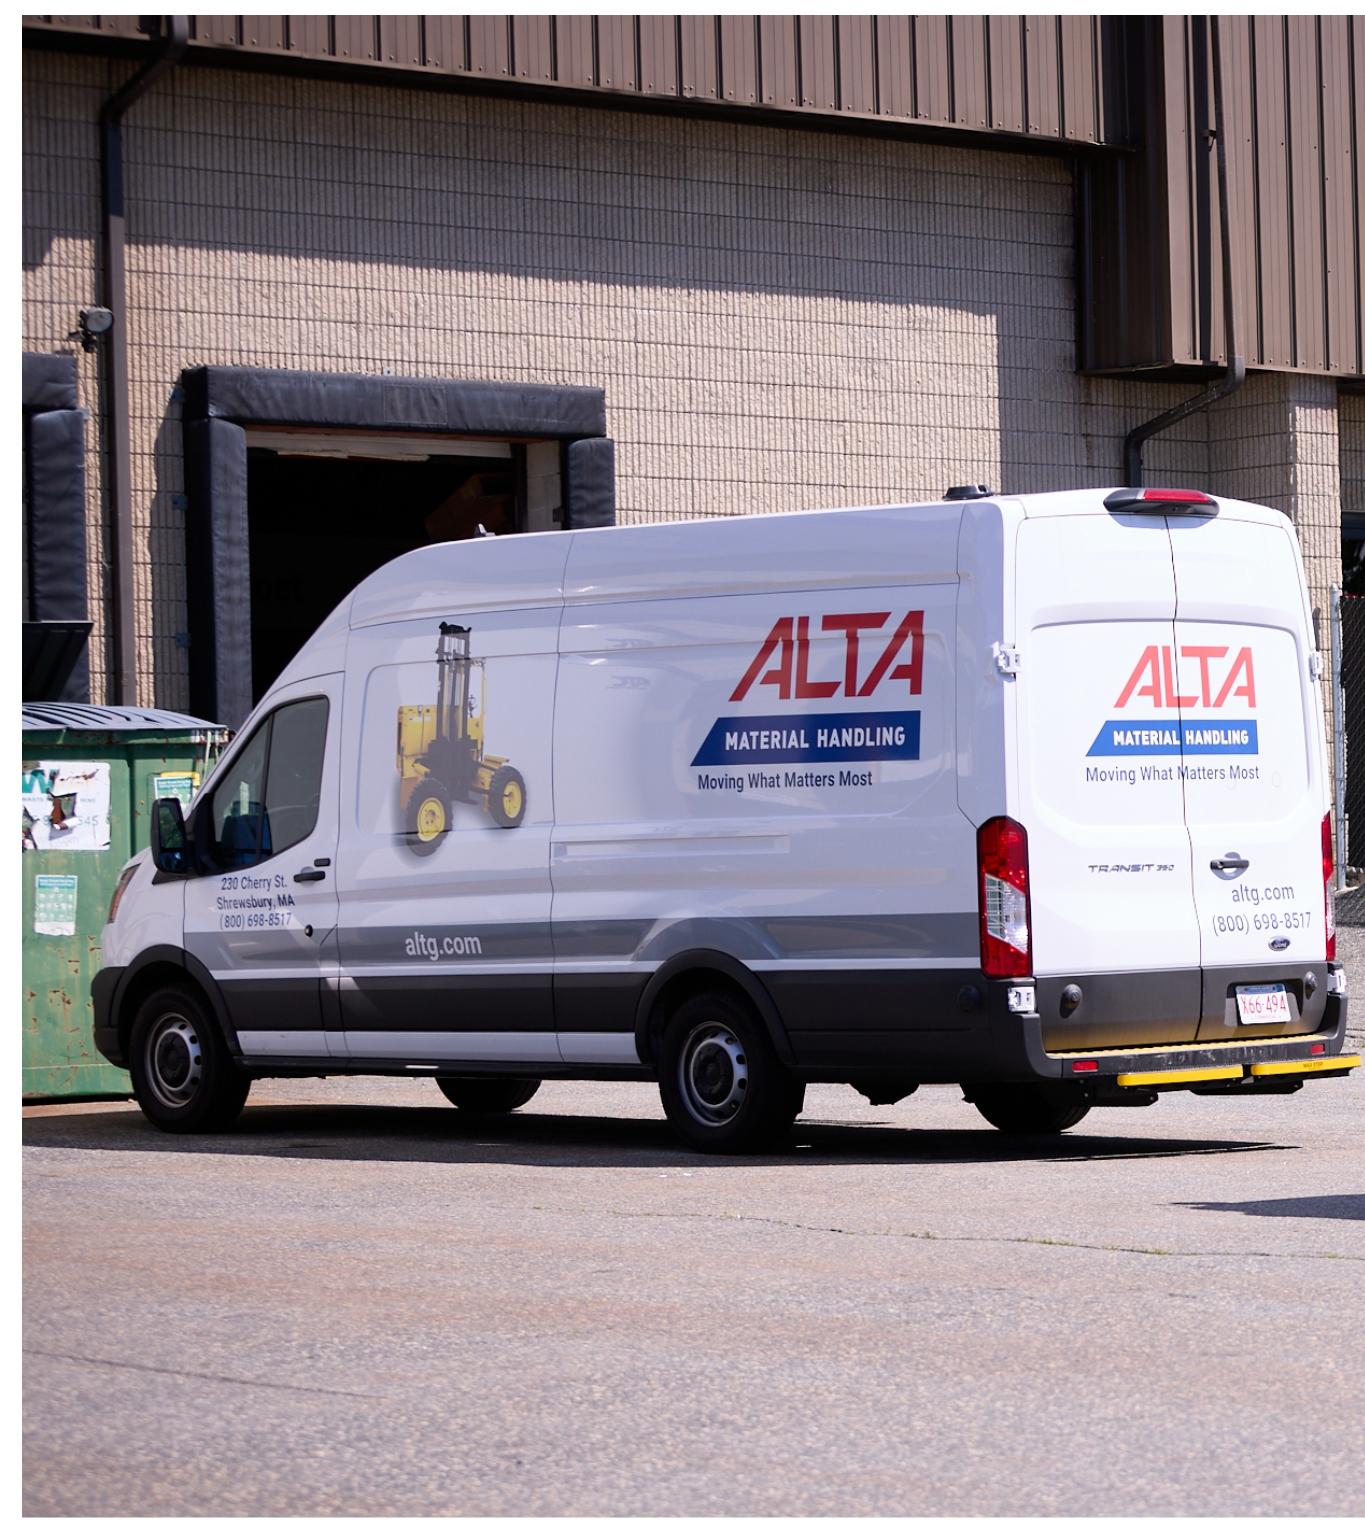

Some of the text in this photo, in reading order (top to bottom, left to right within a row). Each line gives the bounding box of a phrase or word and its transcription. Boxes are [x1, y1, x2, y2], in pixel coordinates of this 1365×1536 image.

[728, 610, 925, 702] ALTA
[1113, 645, 1257, 708] ALTA
[724, 726, 906, 751] MATERIAL HANDLING
[1113, 730, 1249, 746] MATERIAL HANDLING
[698, 770, 873, 793] Moving What Matters Most
[1086, 765, 1260, 785] Moving What Matters Most
[1088, 864, 1155, 873] TRANSIT
[220, 874, 288, 892] 230 Cherry St.
[216, 893, 296, 911] Shrewsbury, MA
[1231, 884, 1295, 906] altg.com
[220, 912, 292, 930] (800) 698-8517
[1212, 911, 1312, 937] (800) 698-8517
[405, 931, 483, 961] altg.com
